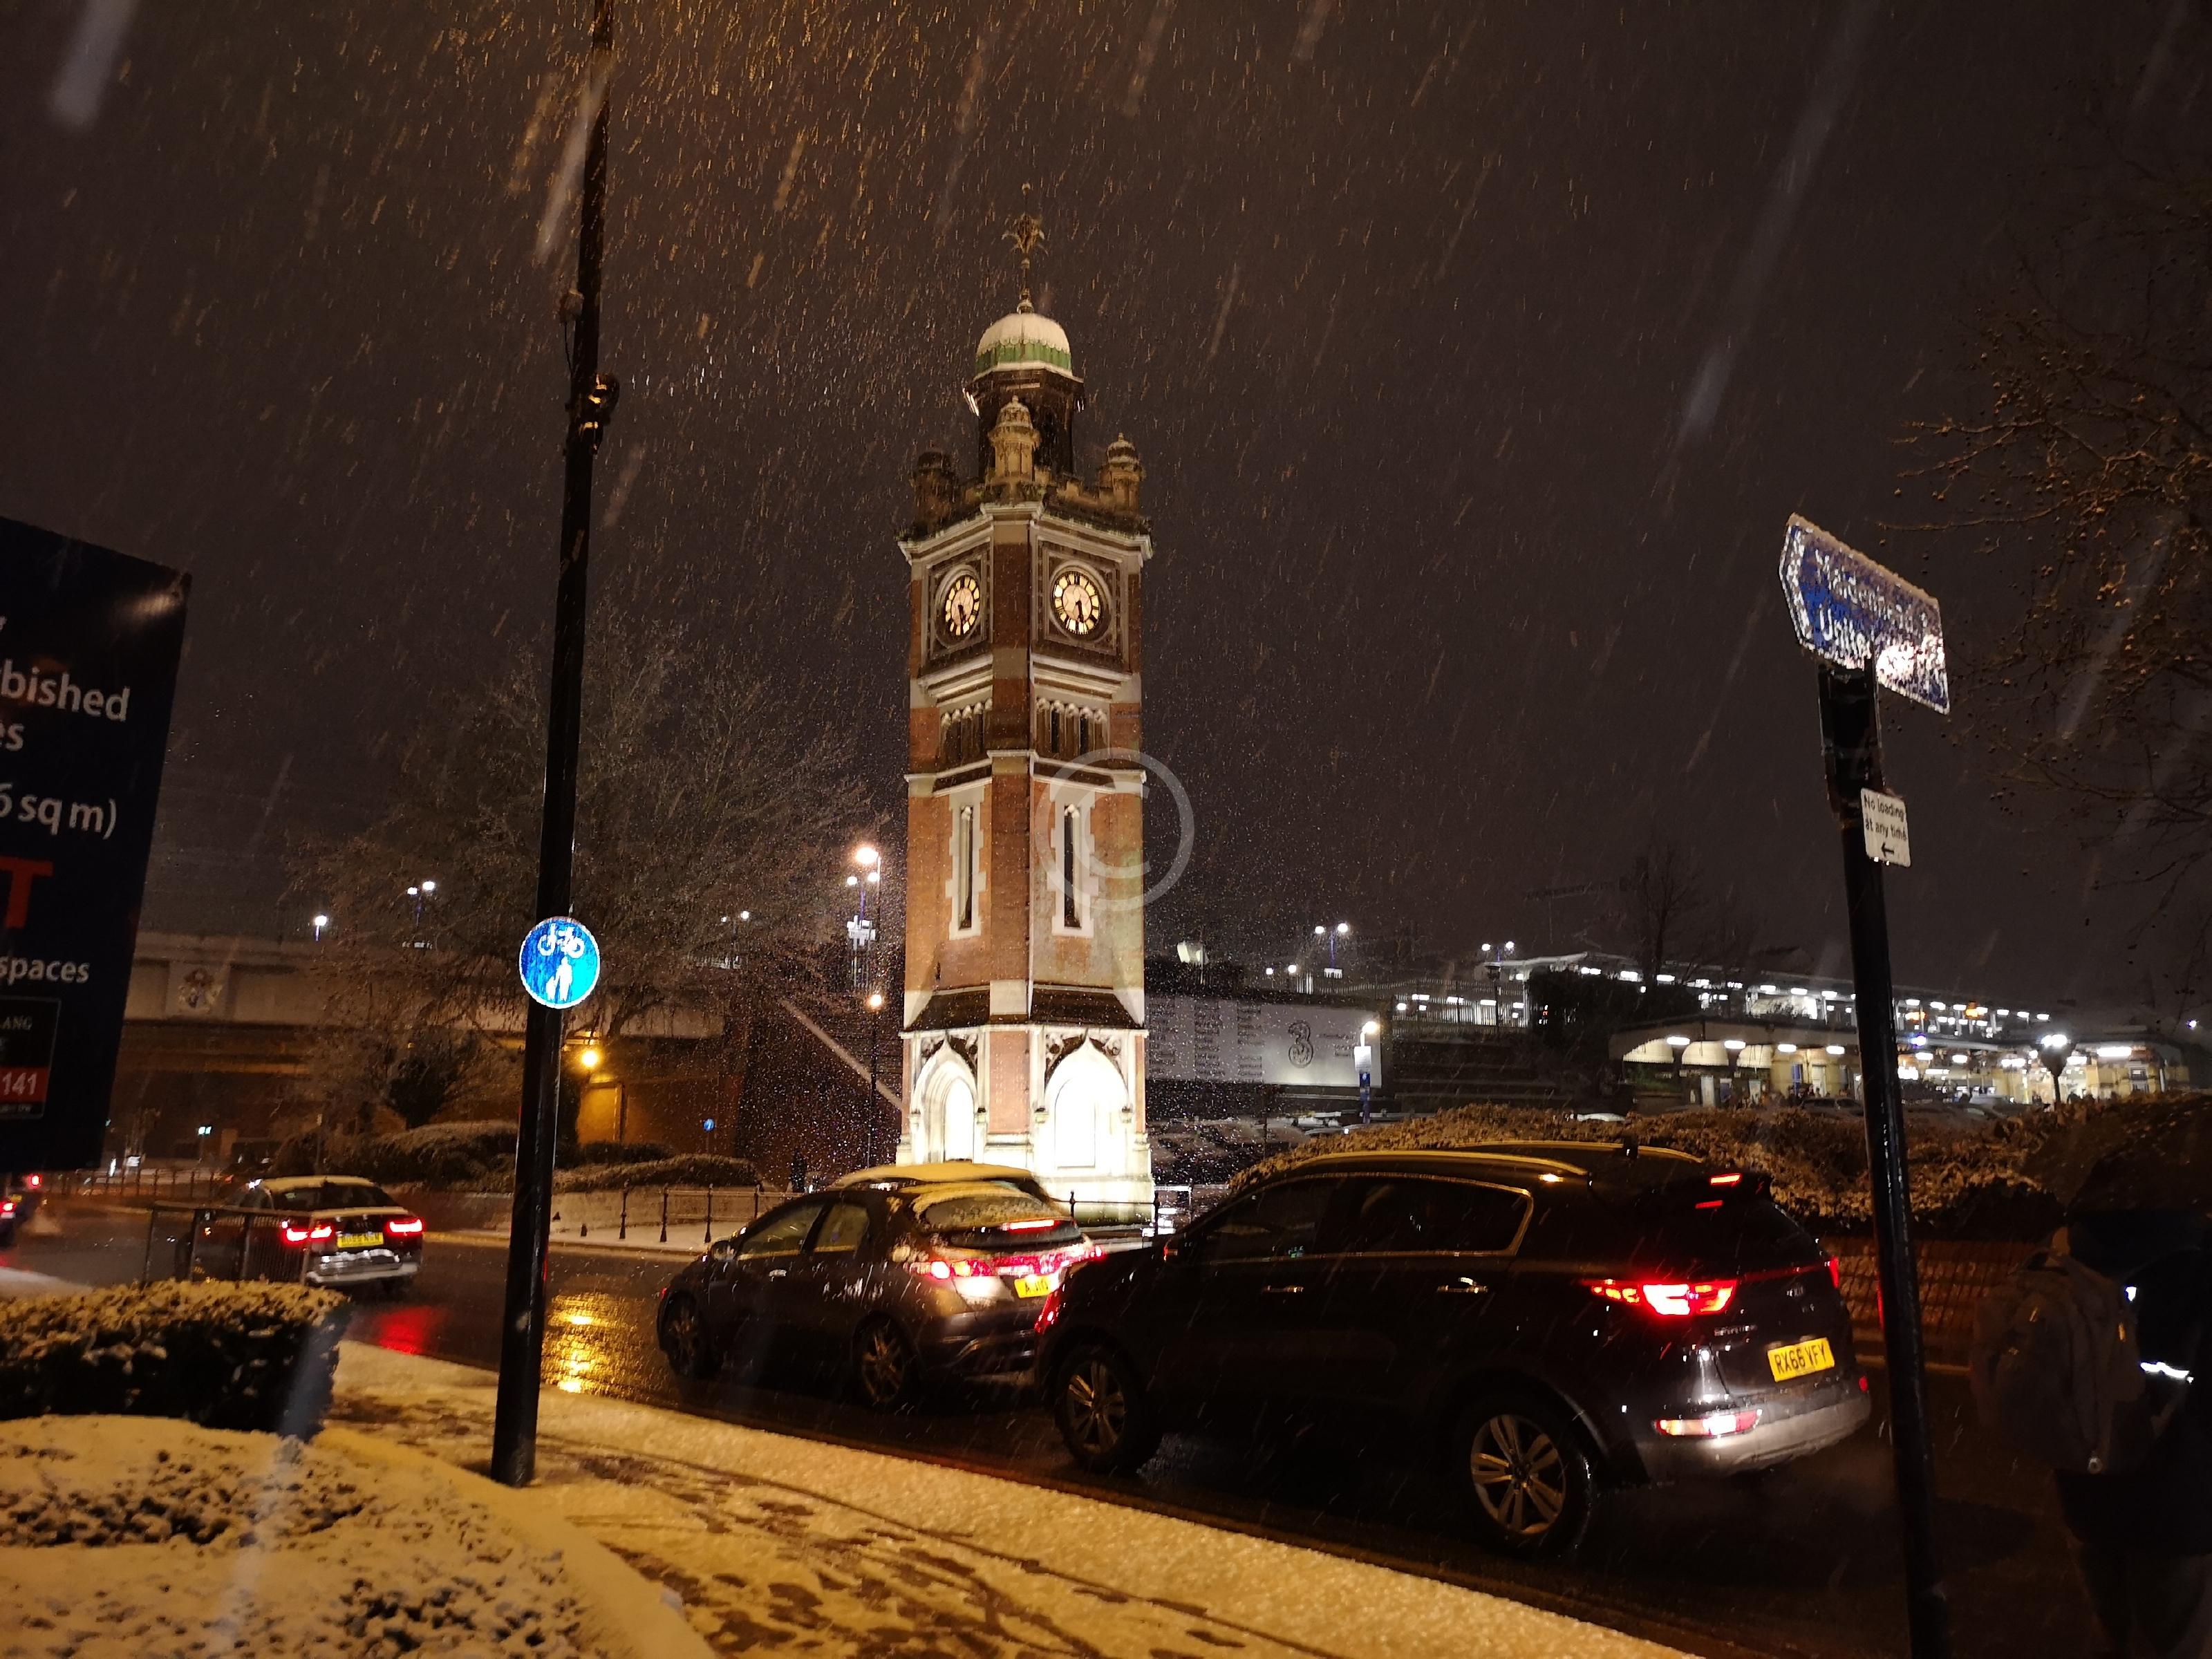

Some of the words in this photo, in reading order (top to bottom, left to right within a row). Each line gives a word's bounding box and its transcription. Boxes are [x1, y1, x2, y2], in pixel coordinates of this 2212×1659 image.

[0, 659, 131, 722] bished
[17, 794, 62, 836] sq
[68, 798, 117, 841] m)
[1864, 794, 1875, 810] No
[1877, 798, 1904, 823] loading
[1865, 817, 1873, 832] at
[1875, 821, 1888, 838] any
[1891, 824, 1907, 841] time
[0, 956, 91, 986] spaces
[2, 1071, 38, 1096] 141
